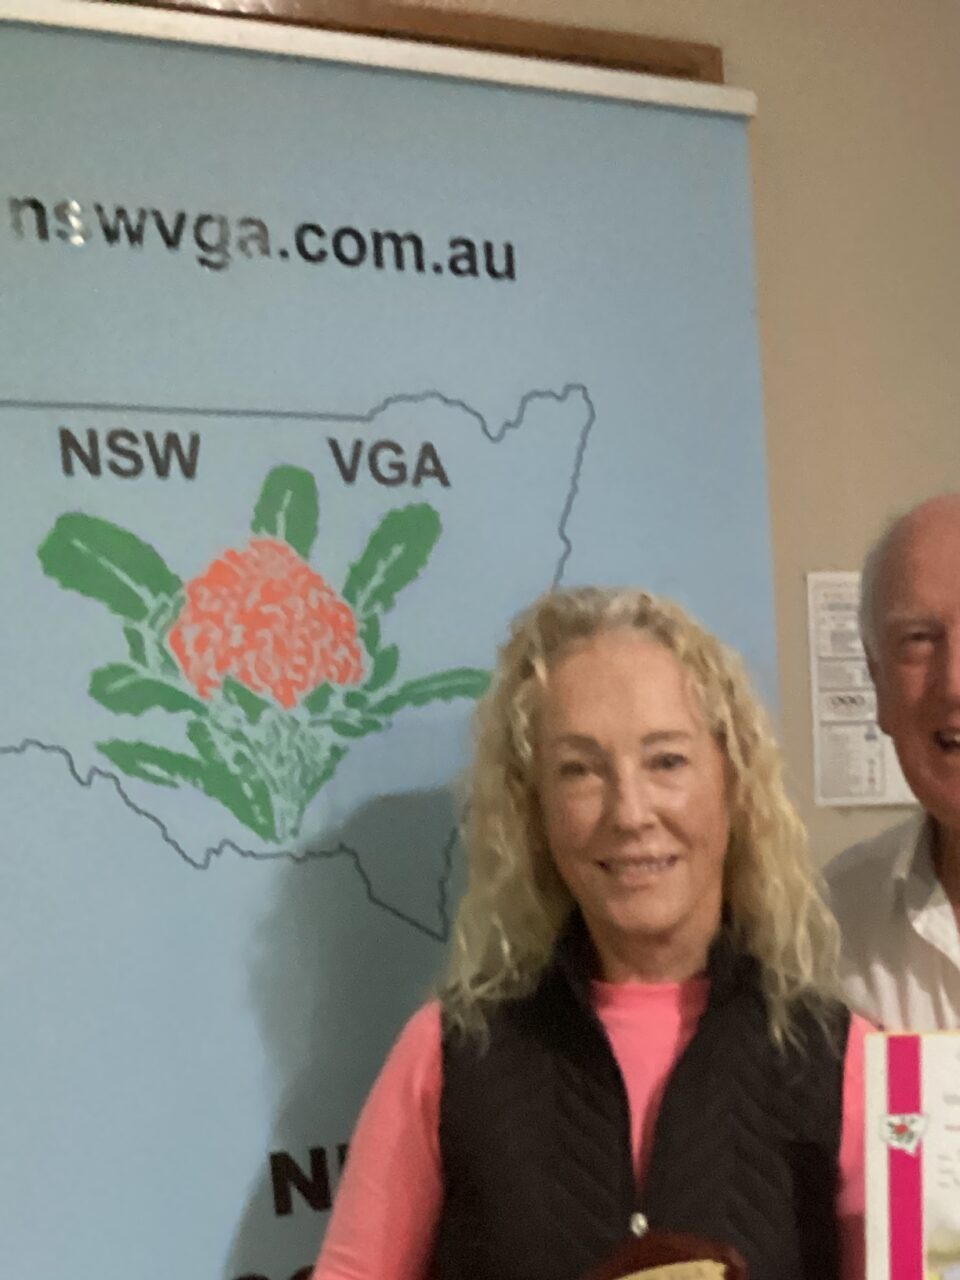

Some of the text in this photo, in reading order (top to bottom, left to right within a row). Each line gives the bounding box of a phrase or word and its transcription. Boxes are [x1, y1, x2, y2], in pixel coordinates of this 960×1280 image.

[8, 195, 516, 281] nswvga.com.au
[58, 426, 451, 488] NSW VGA
